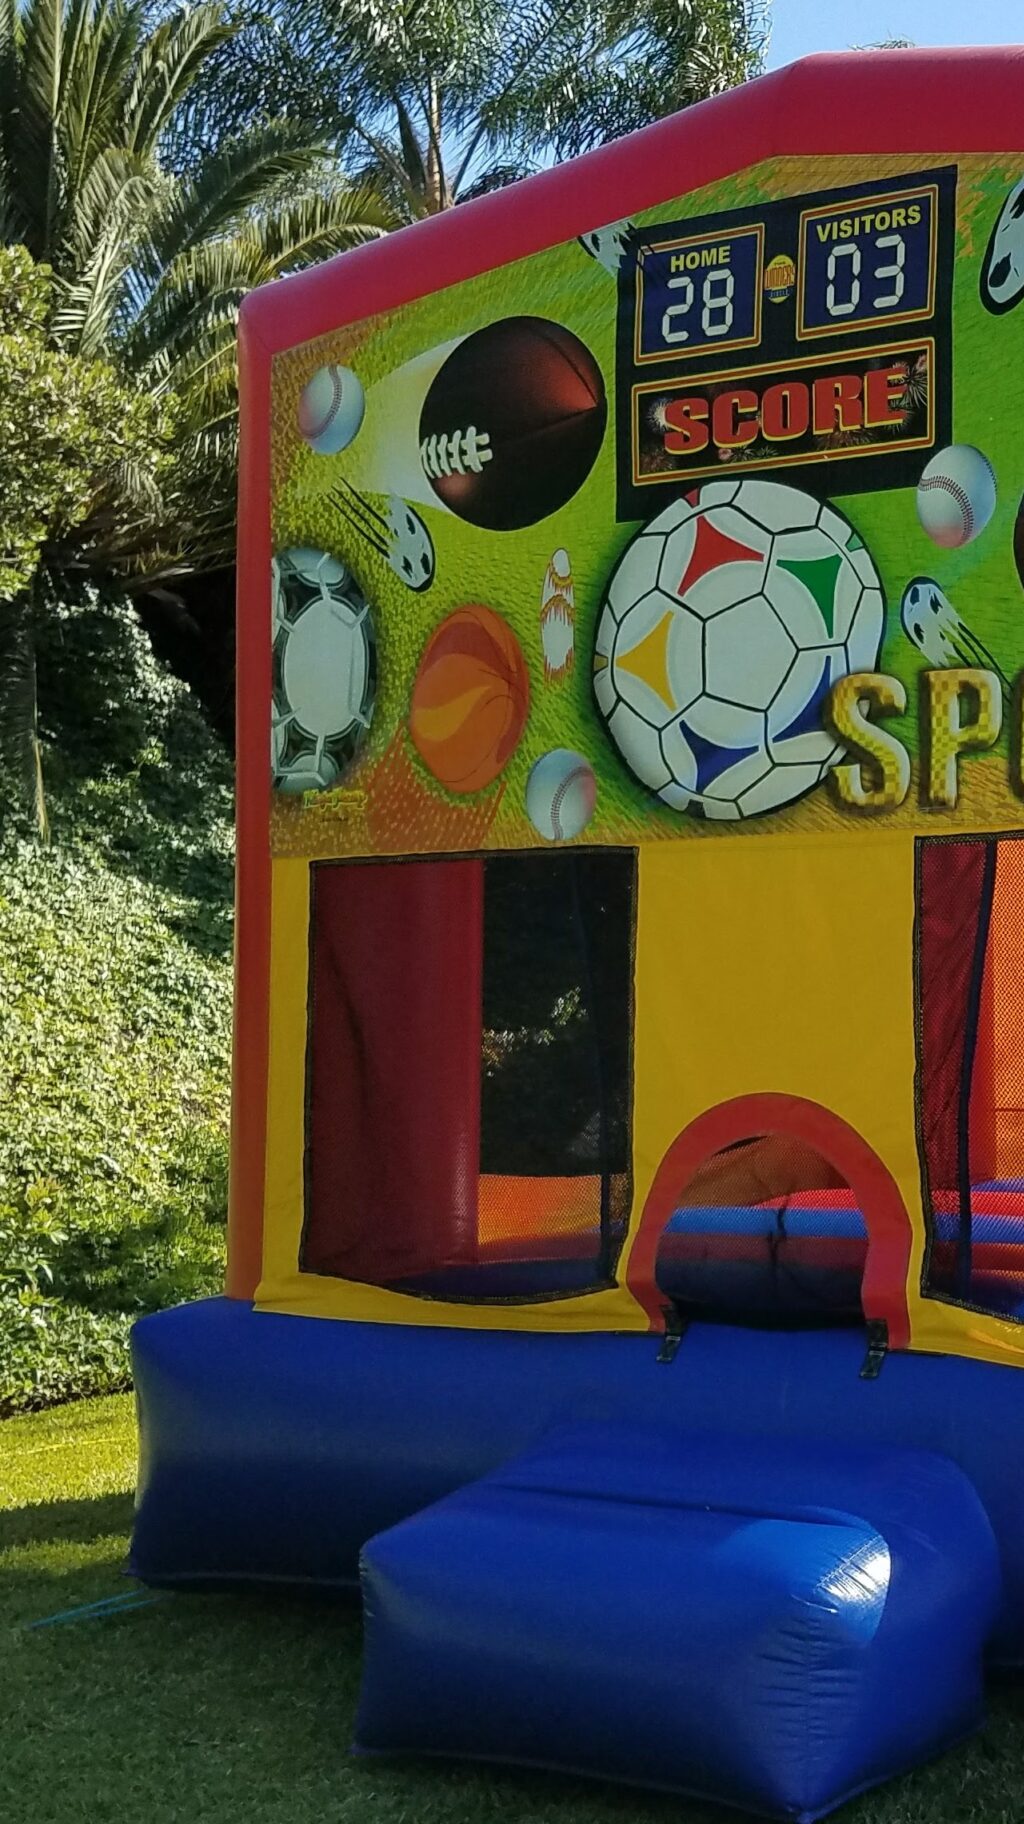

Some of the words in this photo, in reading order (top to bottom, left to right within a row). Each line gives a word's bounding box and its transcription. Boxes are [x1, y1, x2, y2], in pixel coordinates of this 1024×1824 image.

[669, 245, 731, 273] HOME
[816, 204, 922, 243] VISITORS
[661, 268, 735, 344] 28
[825, 233, 906, 317] 03
[663, 366, 909, 455] SCORE
